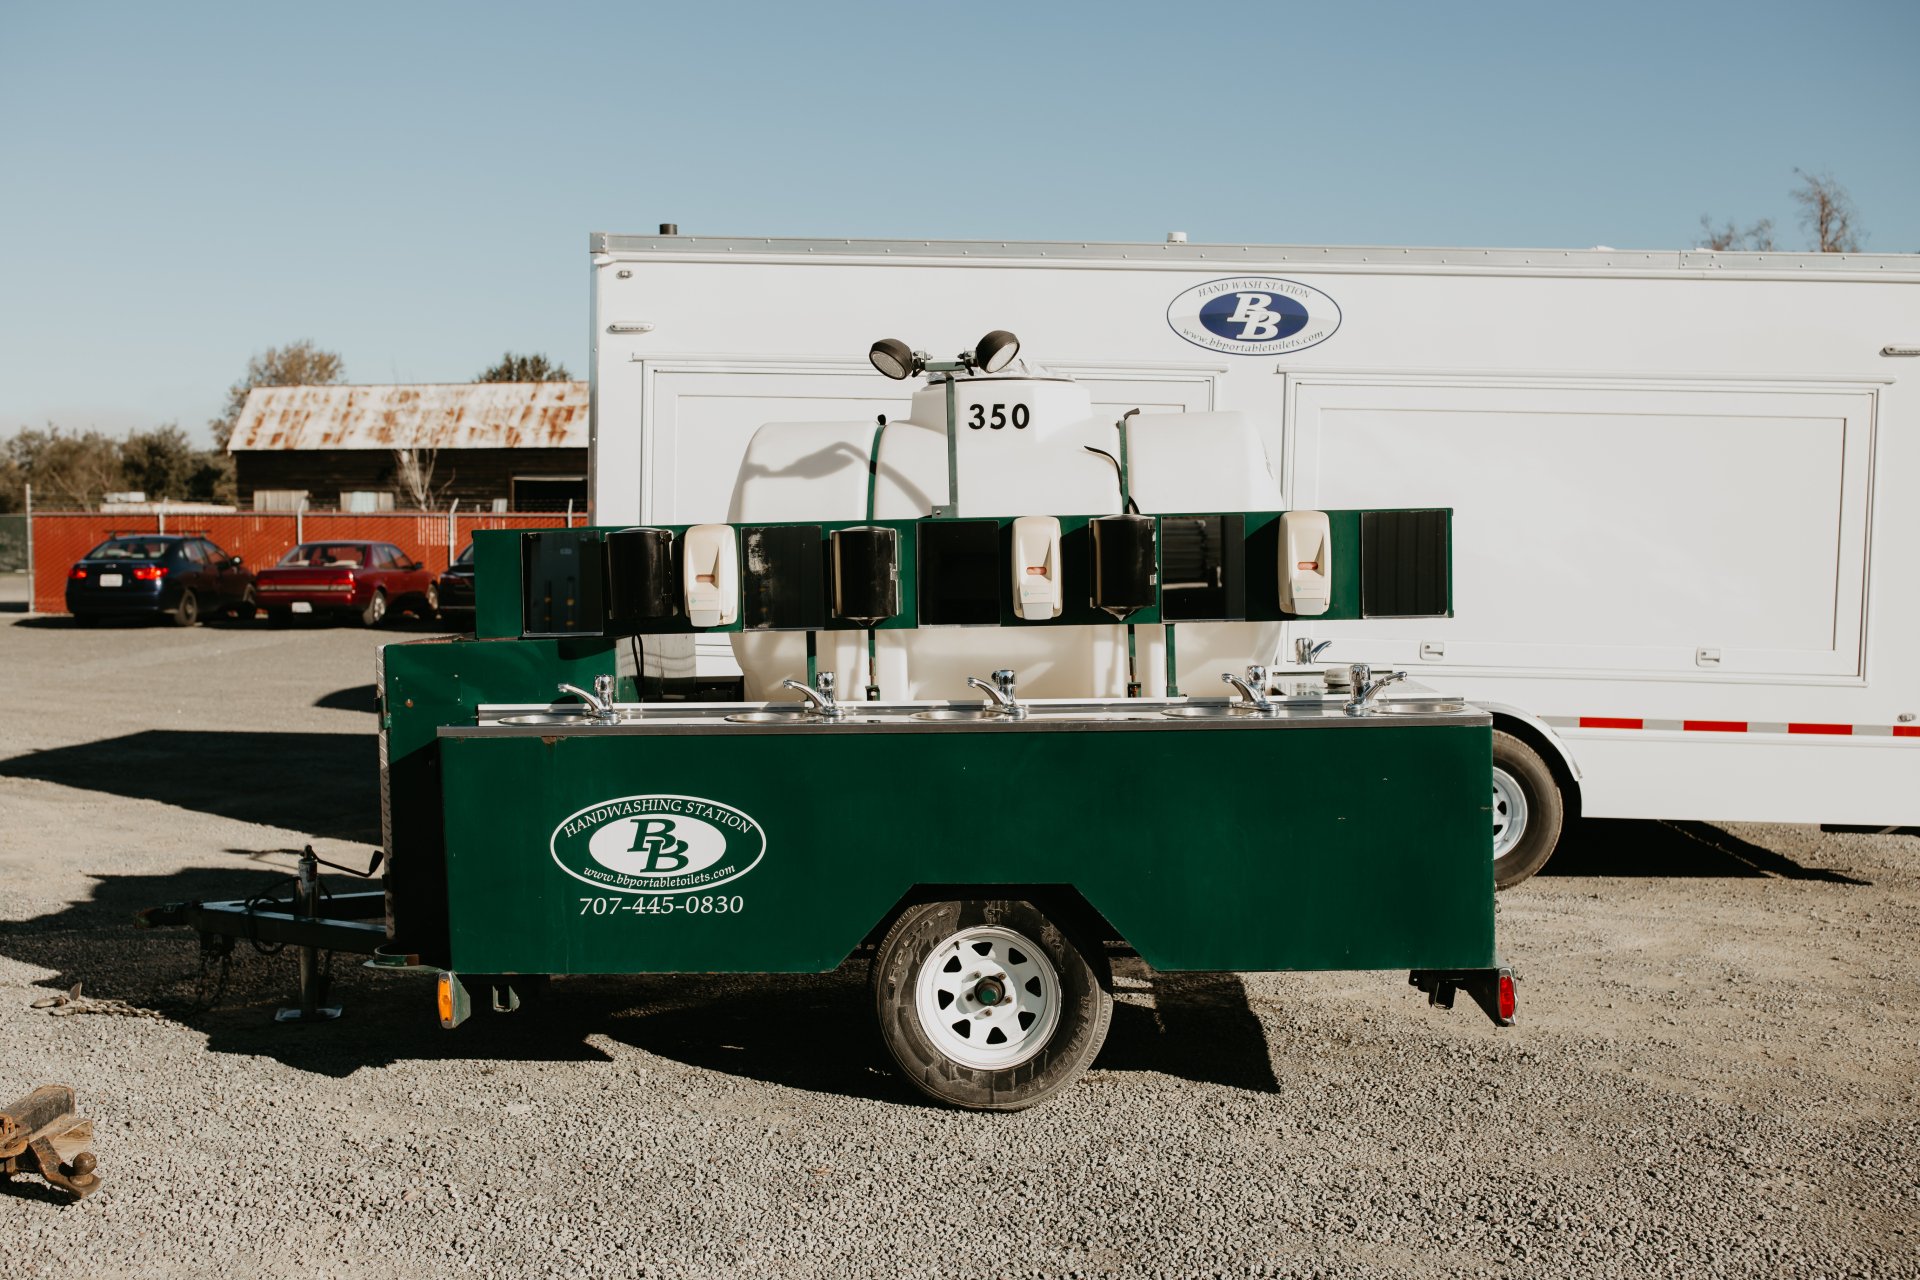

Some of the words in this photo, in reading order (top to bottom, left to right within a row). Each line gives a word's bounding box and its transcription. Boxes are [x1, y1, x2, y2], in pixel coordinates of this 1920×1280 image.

[1198, 284, 1229, 298] HAND
[1232, 280, 1262, 290] WASH
[1265, 281, 1310, 299] STATION
[1183, 328, 1324, 352] www.bbportabletoilets.com
[968, 403, 1030, 430] 350
[564, 798, 682, 838] HANDWASHING
[685, 801, 753, 834] STATION
[583, 865, 735, 888] www.bbportabletoilets.com
[579, 895, 744, 915] 707-445-0830
